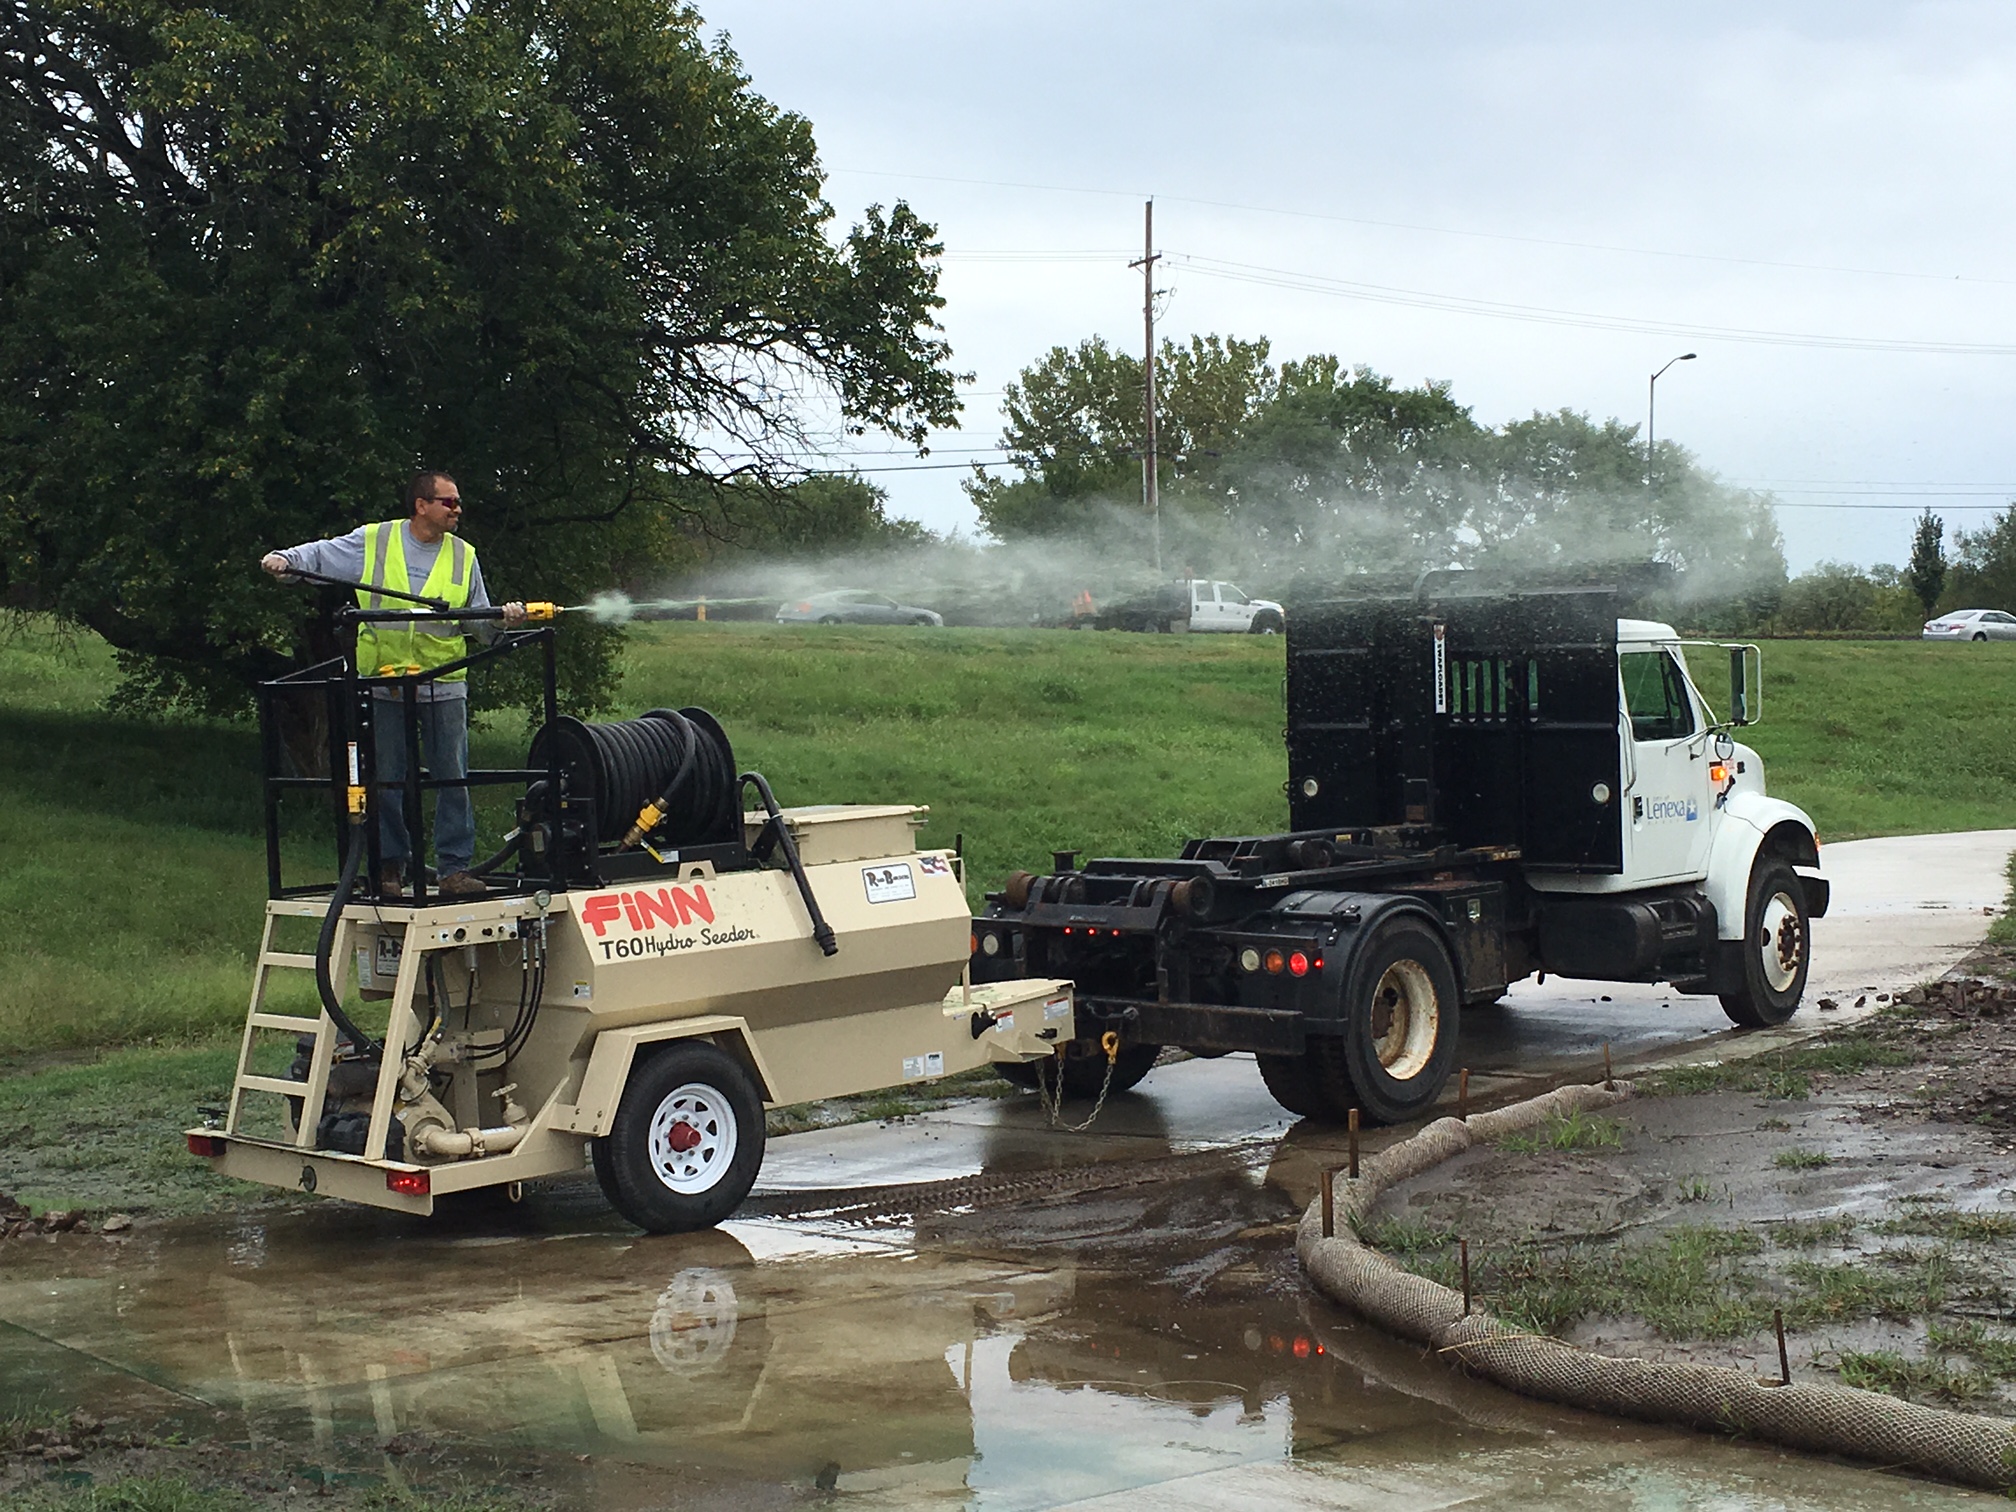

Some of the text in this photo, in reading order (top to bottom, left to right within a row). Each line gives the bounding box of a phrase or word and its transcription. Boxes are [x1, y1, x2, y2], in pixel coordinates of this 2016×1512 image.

[1646, 797, 1685, 820] Lenexa
[598, 925, 756, 960] T60 Hydro Seeder
